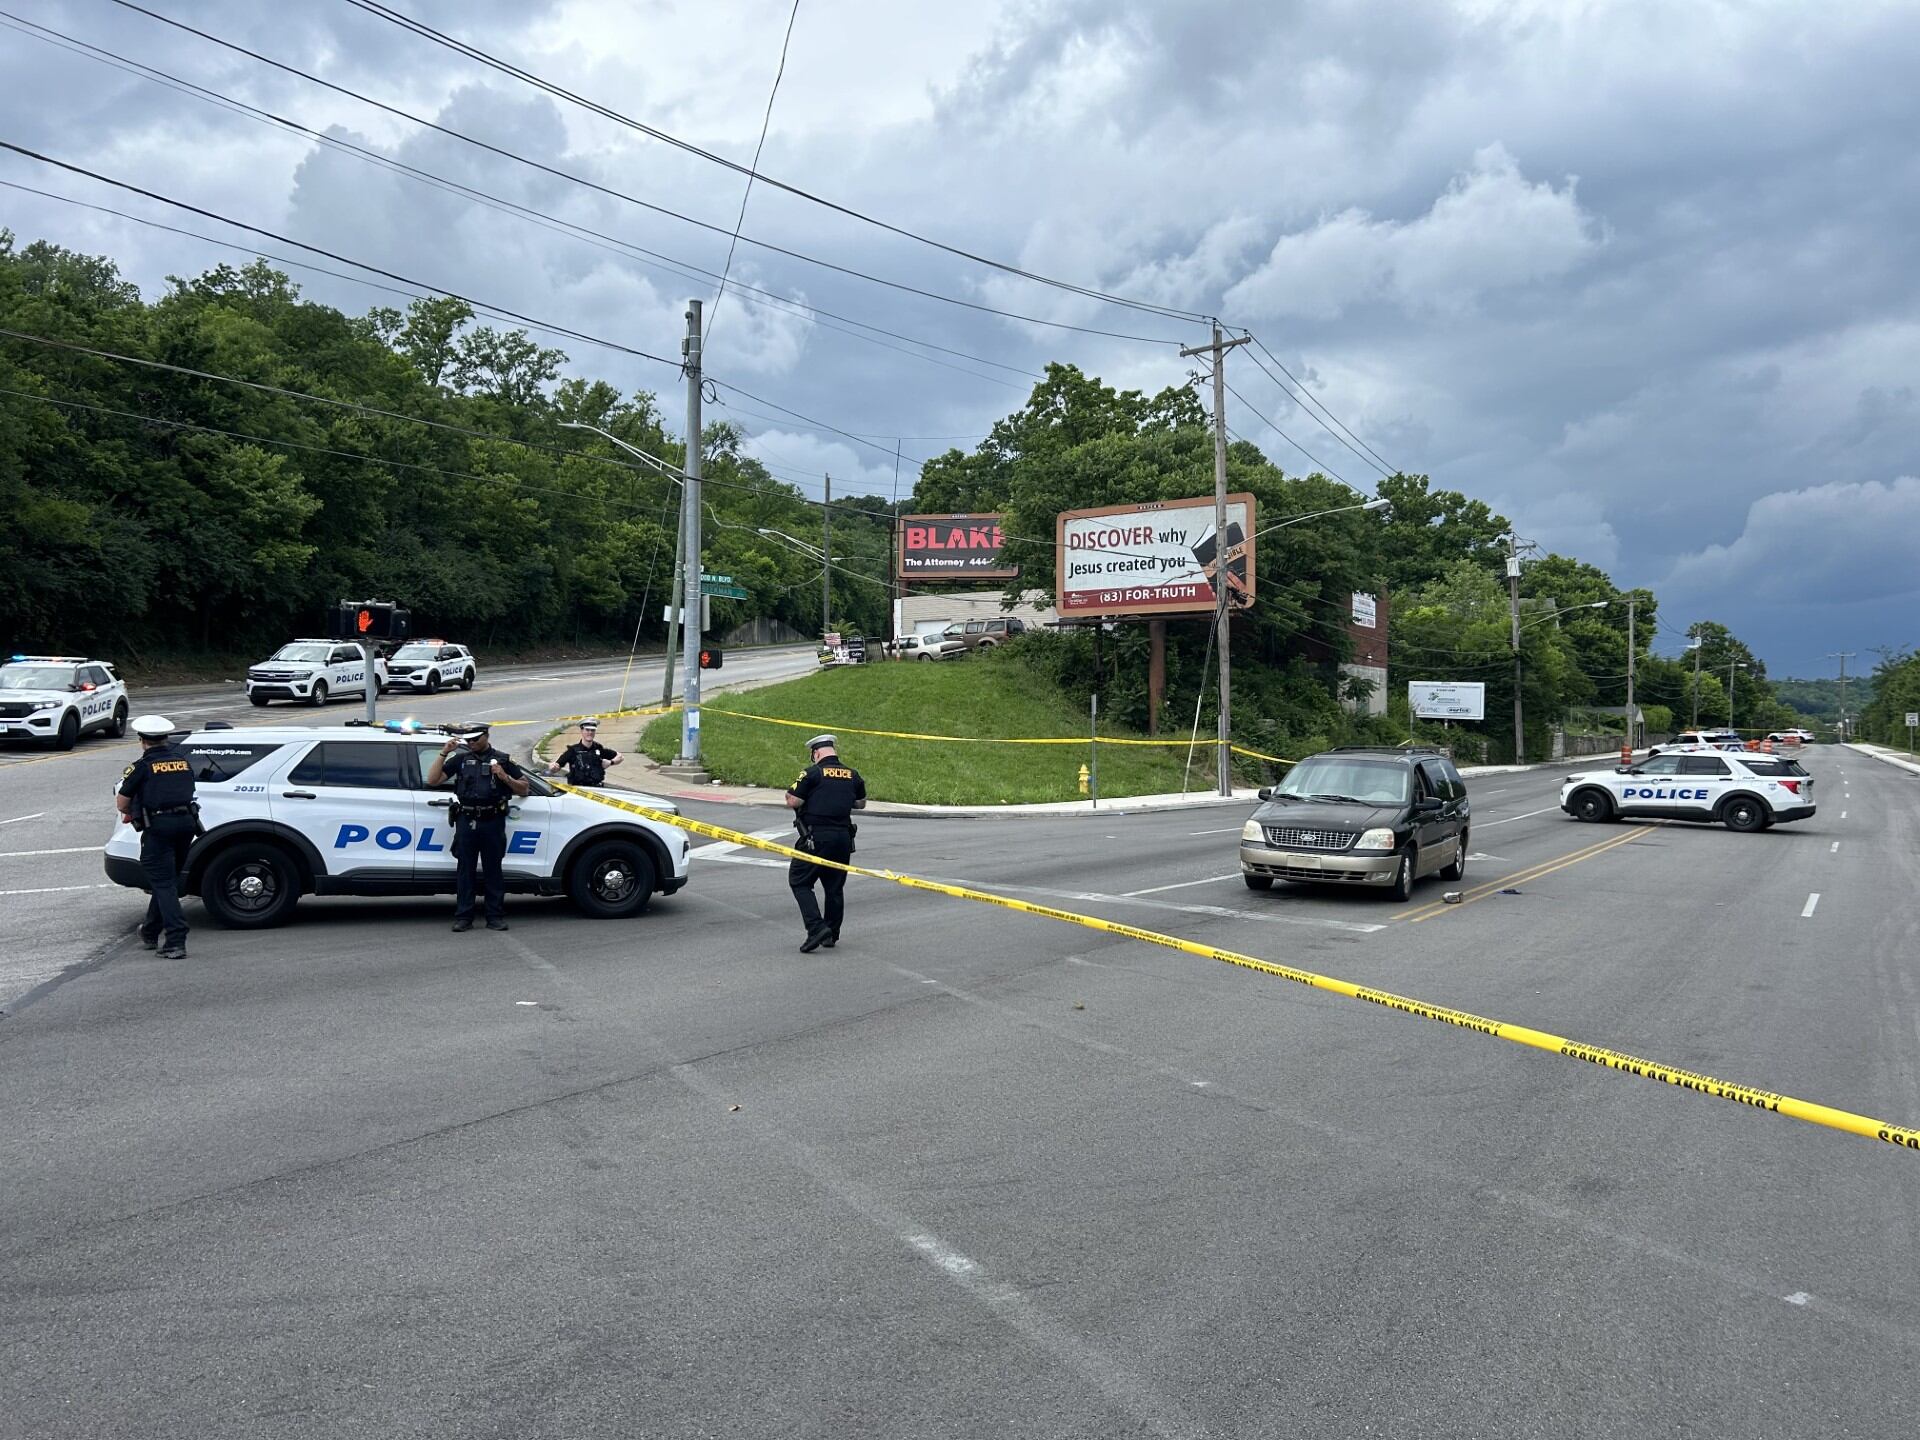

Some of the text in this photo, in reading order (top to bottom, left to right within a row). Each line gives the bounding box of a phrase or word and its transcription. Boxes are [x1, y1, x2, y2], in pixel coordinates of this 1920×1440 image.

[1070, 526, 1187, 550] DISCOVER why
[905, 557, 995, 567] The Attorney 444-
[1068, 556, 1185, 579] Jesus created you
[1100, 591, 1122, 603] (83)
[1126, 586, 1196, 600] FOR-TRUTH
[442, 667, 462, 676] POLICE
[336, 672, 364, 683] POLICE
[82, 700, 112, 718] POLICE
[190, 748, 252, 756] JoinCincyPD.com
[152, 763, 189, 773] POLICE
[823, 768, 853, 779] POLICE
[233, 785, 265, 793] 20331
[1623, 788, 1709, 801] POLICE
[334, 824, 542, 855] POLE
